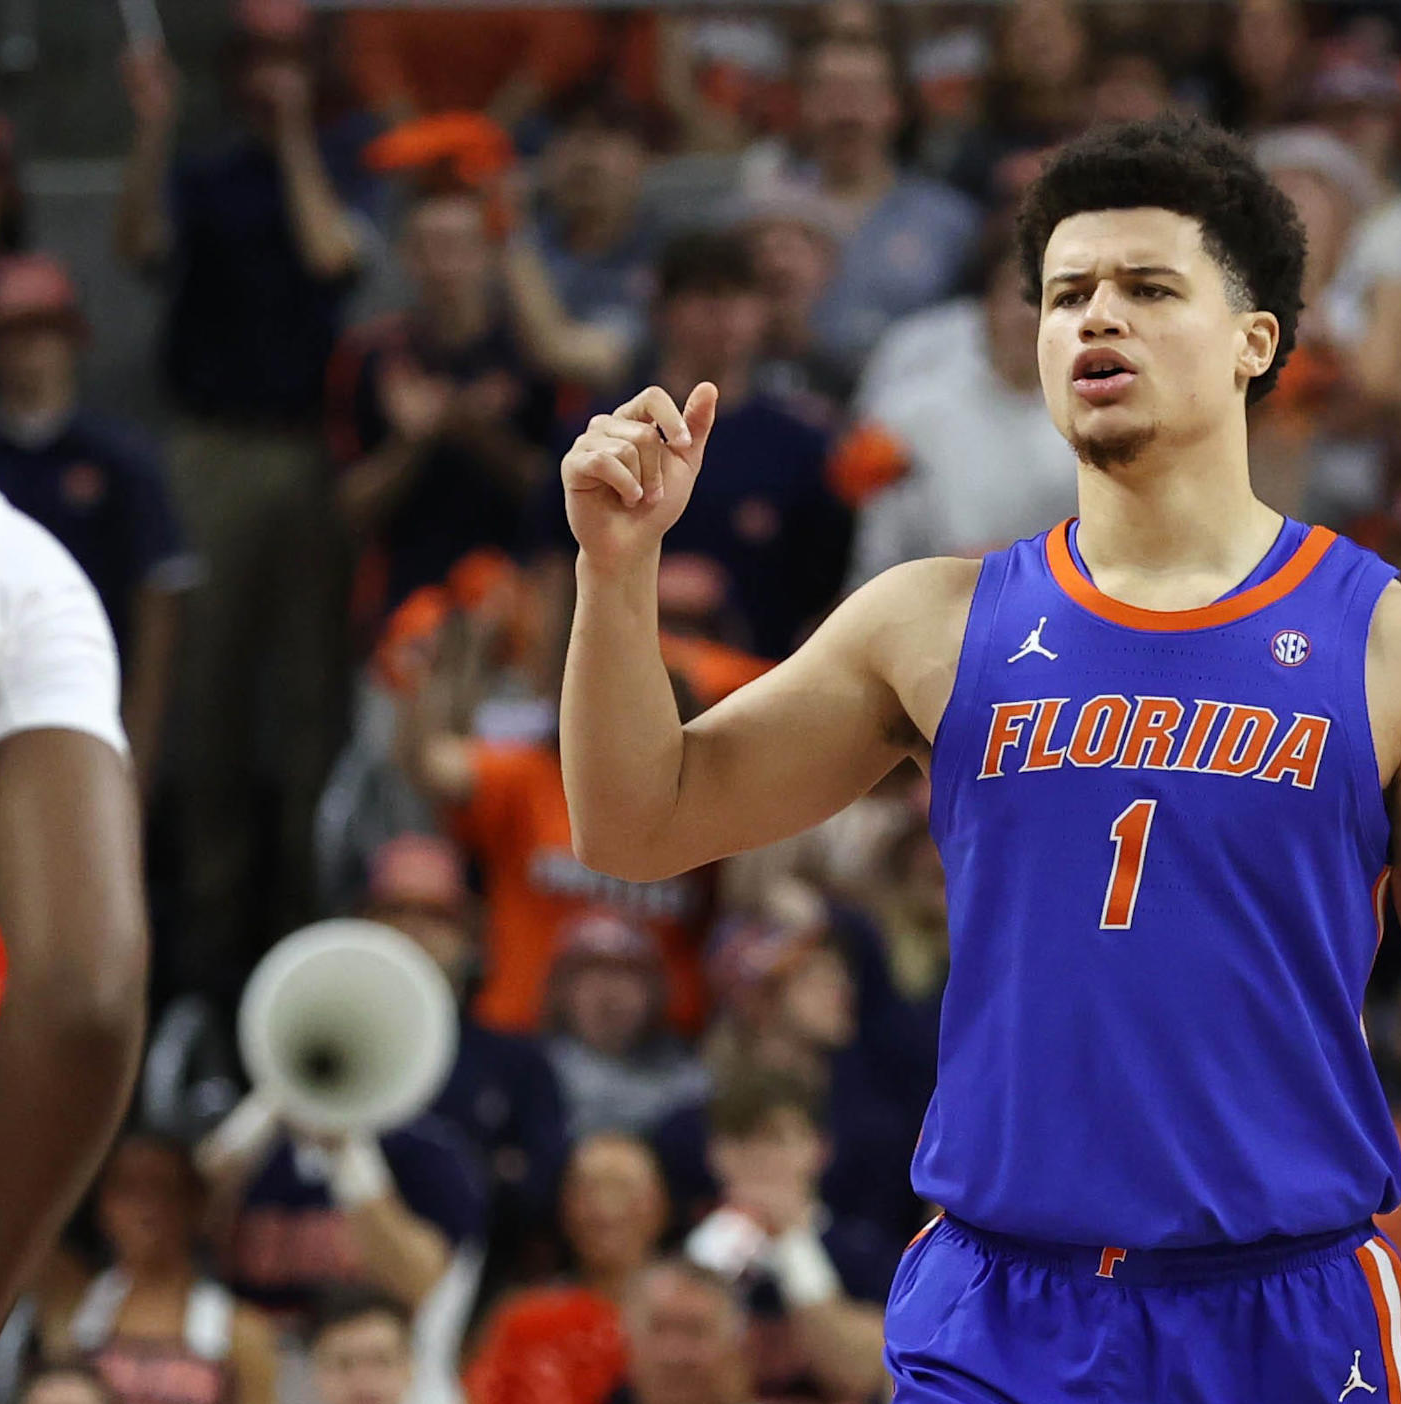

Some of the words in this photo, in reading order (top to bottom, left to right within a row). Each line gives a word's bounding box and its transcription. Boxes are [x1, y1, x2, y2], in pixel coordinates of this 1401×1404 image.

[1274, 632, 1309, 664] SEC
[977, 695, 1331, 790] FLORIDA
[1098, 799, 1157, 930] 1
